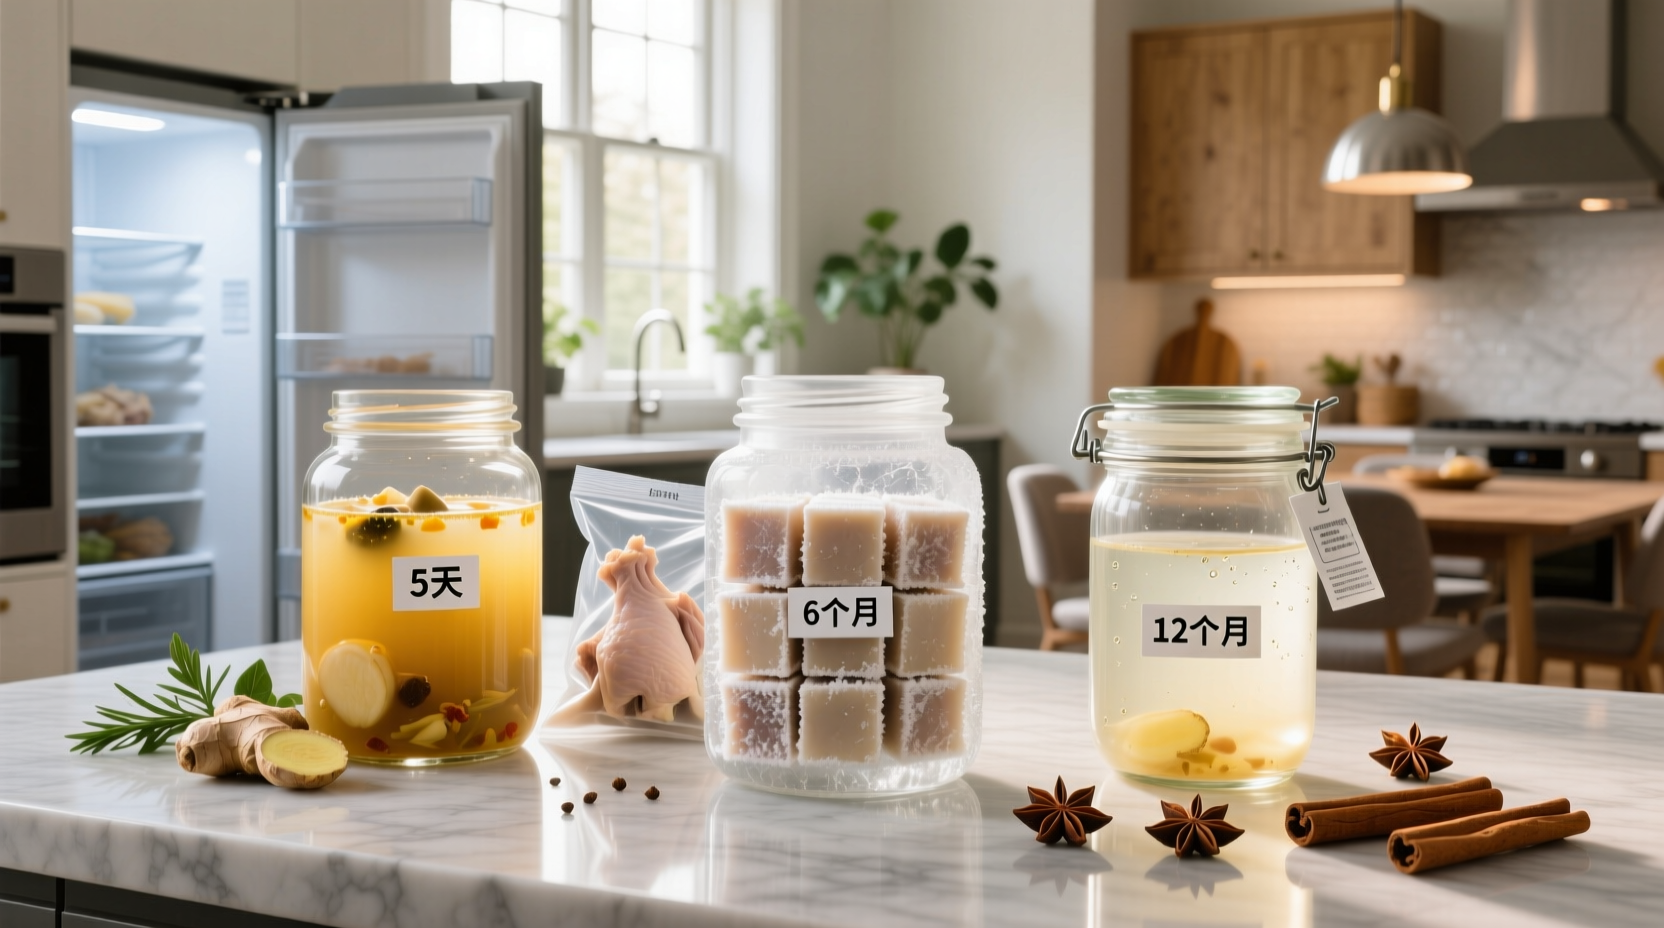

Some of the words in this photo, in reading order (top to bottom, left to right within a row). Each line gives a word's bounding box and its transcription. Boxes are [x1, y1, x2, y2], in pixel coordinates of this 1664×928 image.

[409, 566, 463, 599] 5天
[803, 597, 877, 628] 6个月
[1153, 614, 1248, 648] 12个月
